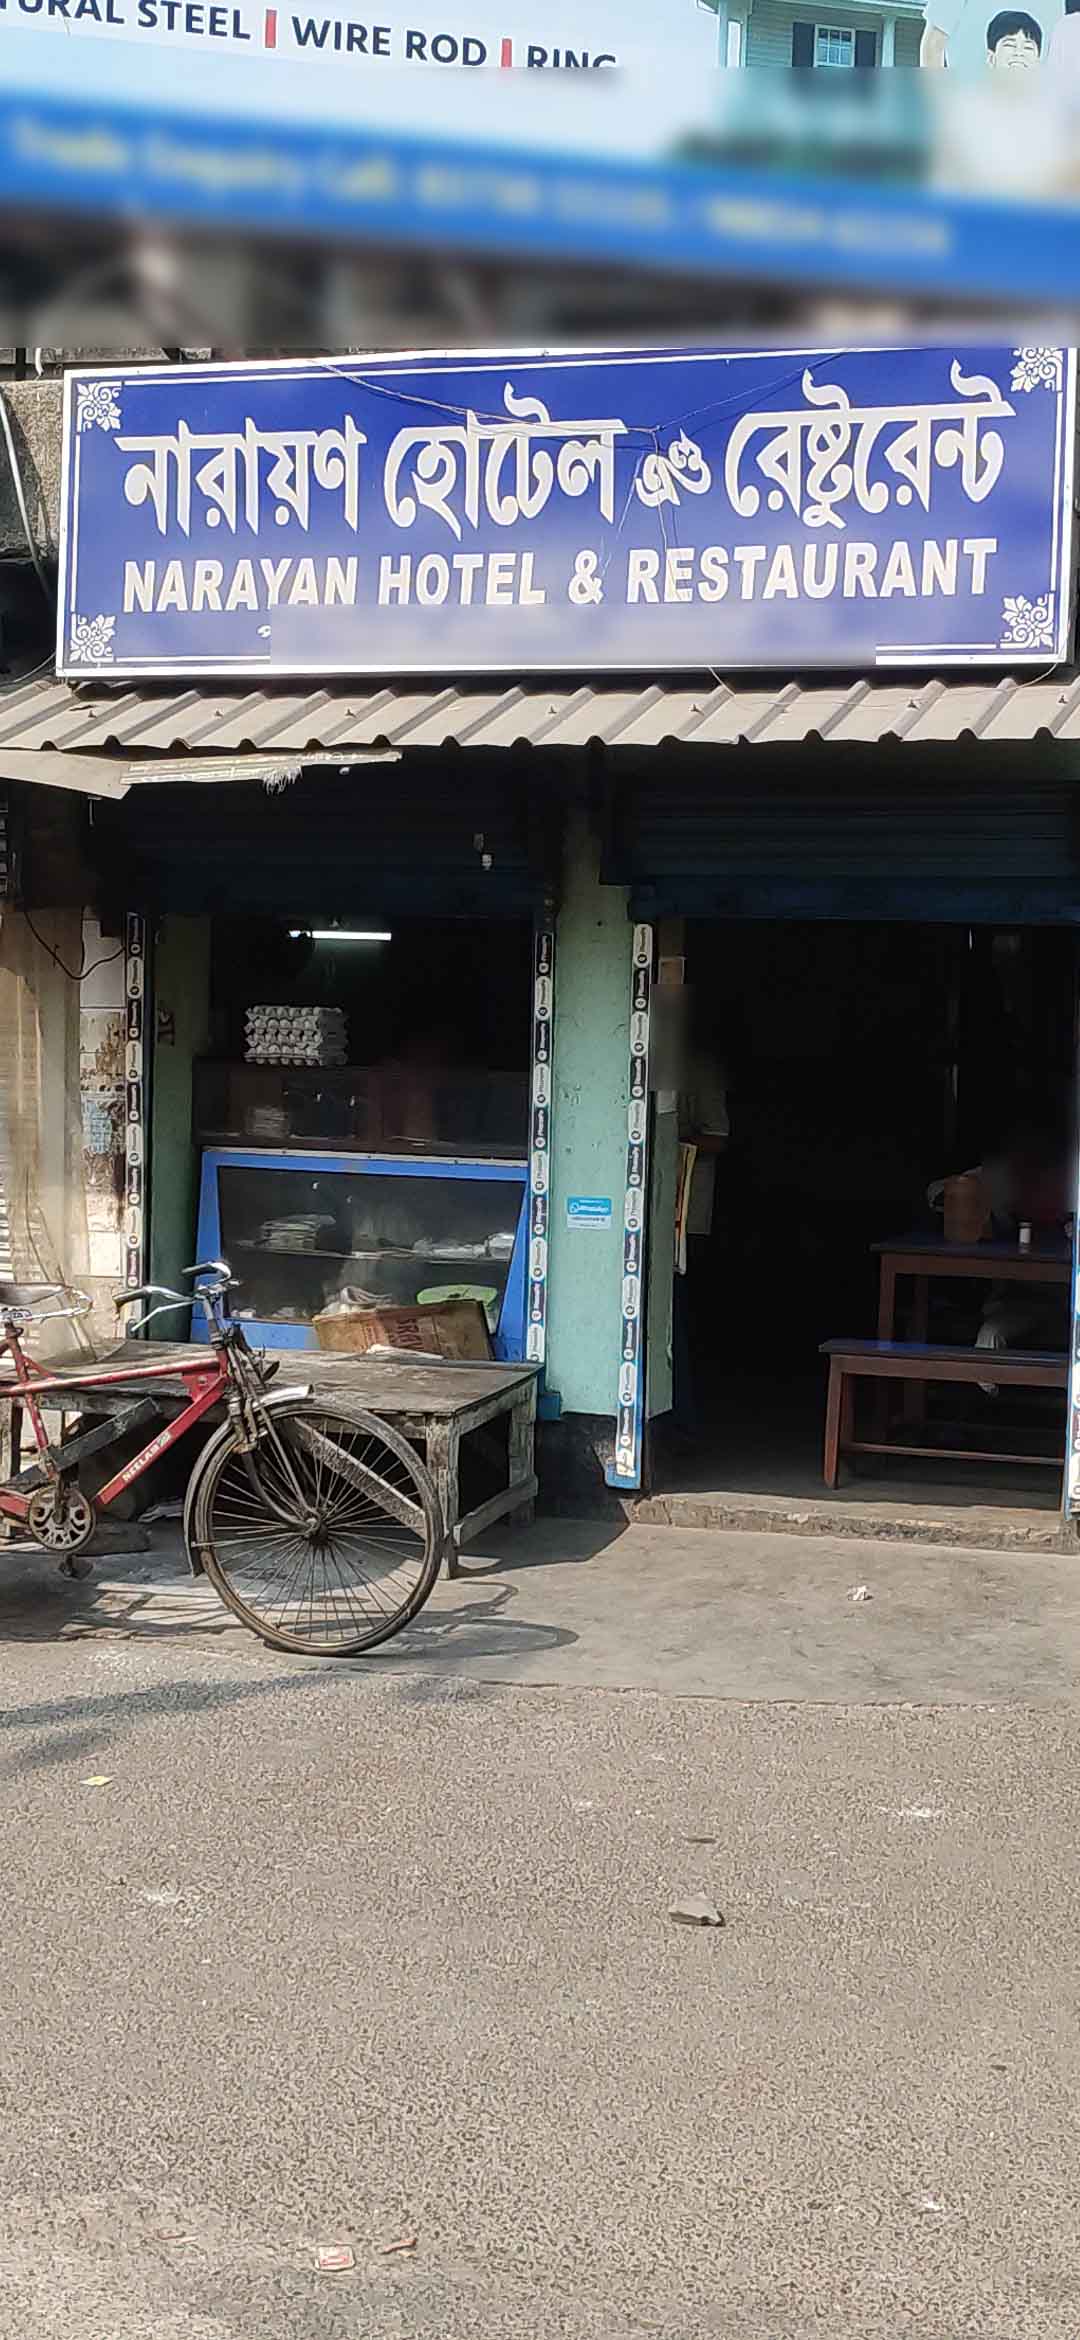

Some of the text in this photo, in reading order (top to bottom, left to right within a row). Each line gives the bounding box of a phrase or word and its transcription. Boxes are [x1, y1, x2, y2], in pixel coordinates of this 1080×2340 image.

[137, 0, 251, 40] STEEL
[291, 15, 391, 56] WIRE
[405, 31, 487, 66] ROD
[114, 415, 367, 537] নারায়ণ
[384, 381, 628, 540] হোটেল
[123, 537, 998, 613] NARAYAN HOTEL & RESTAURANT
